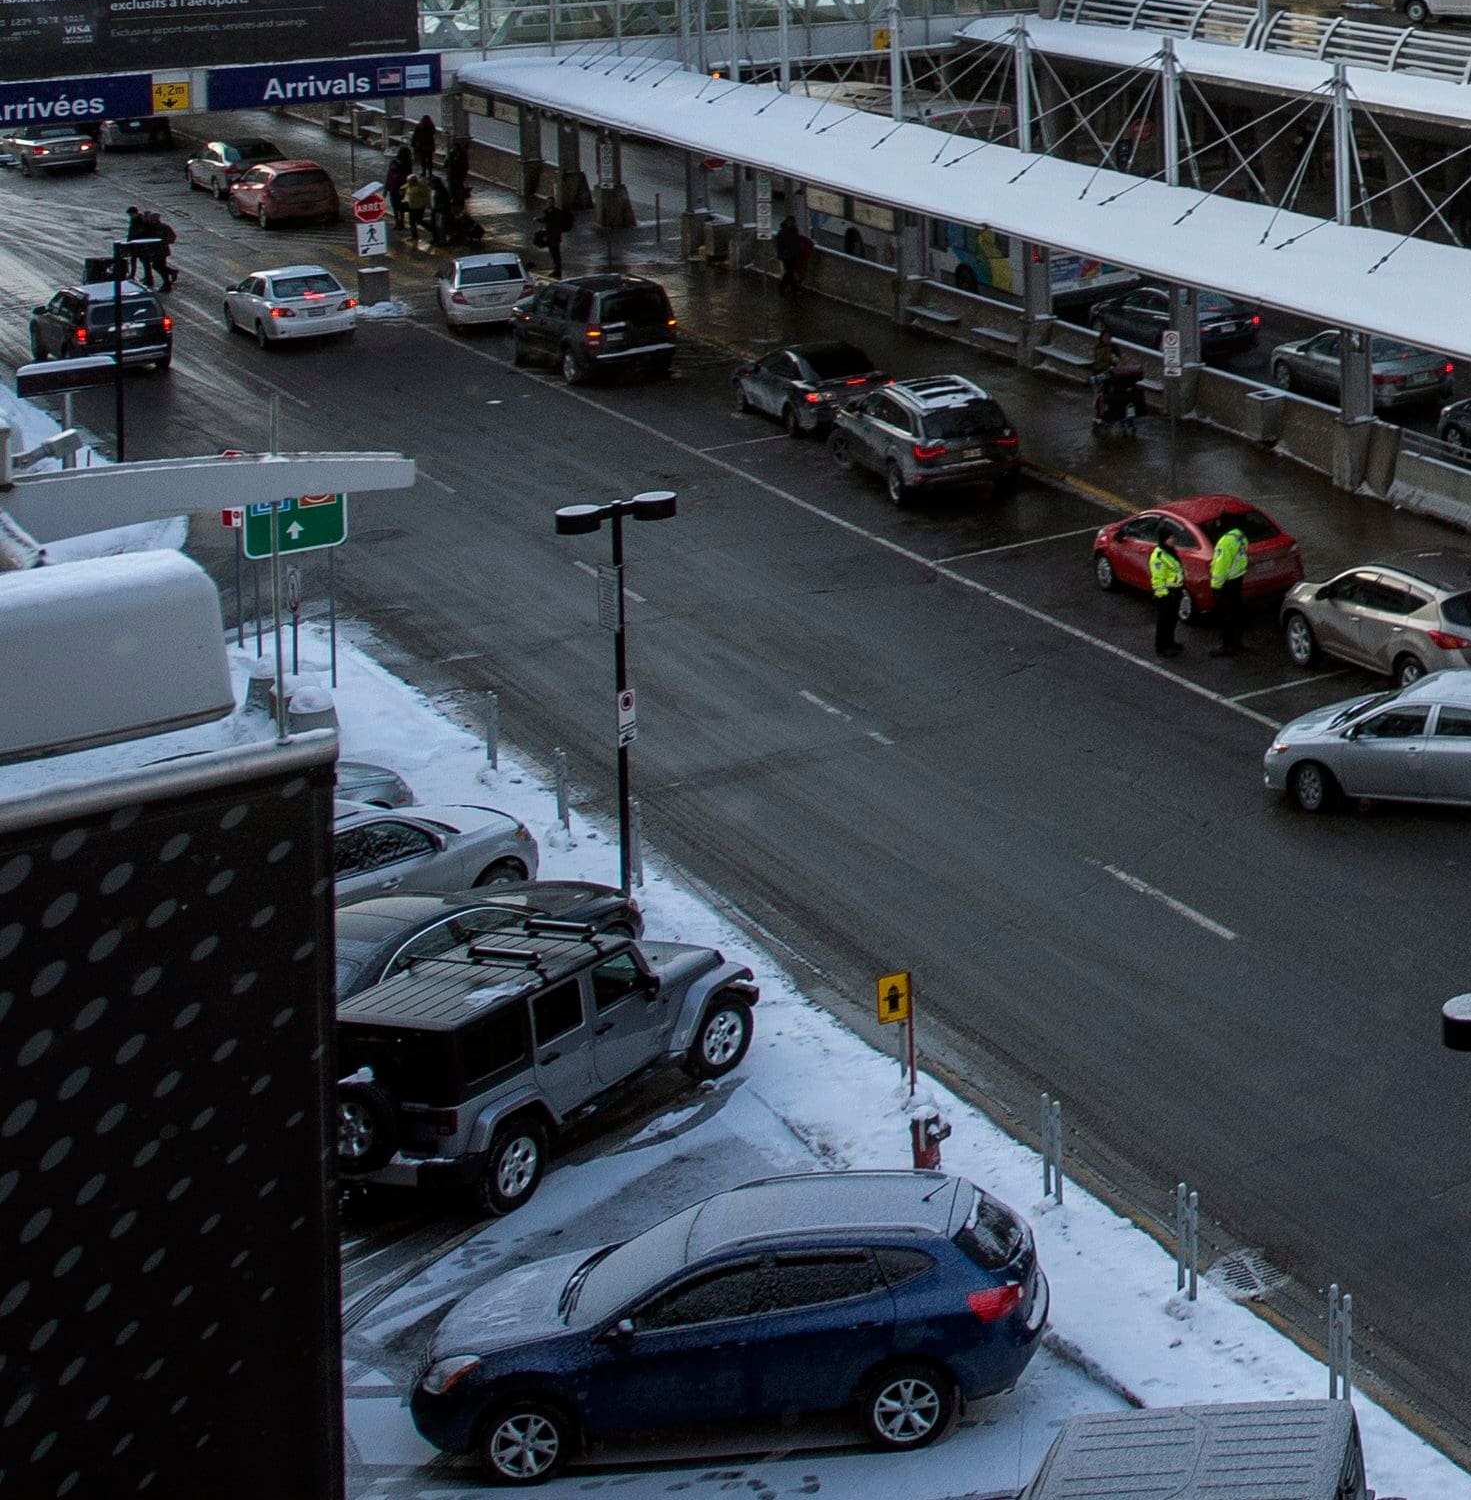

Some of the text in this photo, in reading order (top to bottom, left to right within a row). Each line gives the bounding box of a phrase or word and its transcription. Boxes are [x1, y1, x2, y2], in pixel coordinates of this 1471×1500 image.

[64, 25, 92, 35] VISA
[110, 27, 151, 38] Exclusive
[152, 24, 183, 36] airport
[256, 18, 274, 29] and
[155, 85, 185, 98] 4,2m
[263, 72, 371, 101] Arrivals
[0, 94, 105, 121] rrivées
